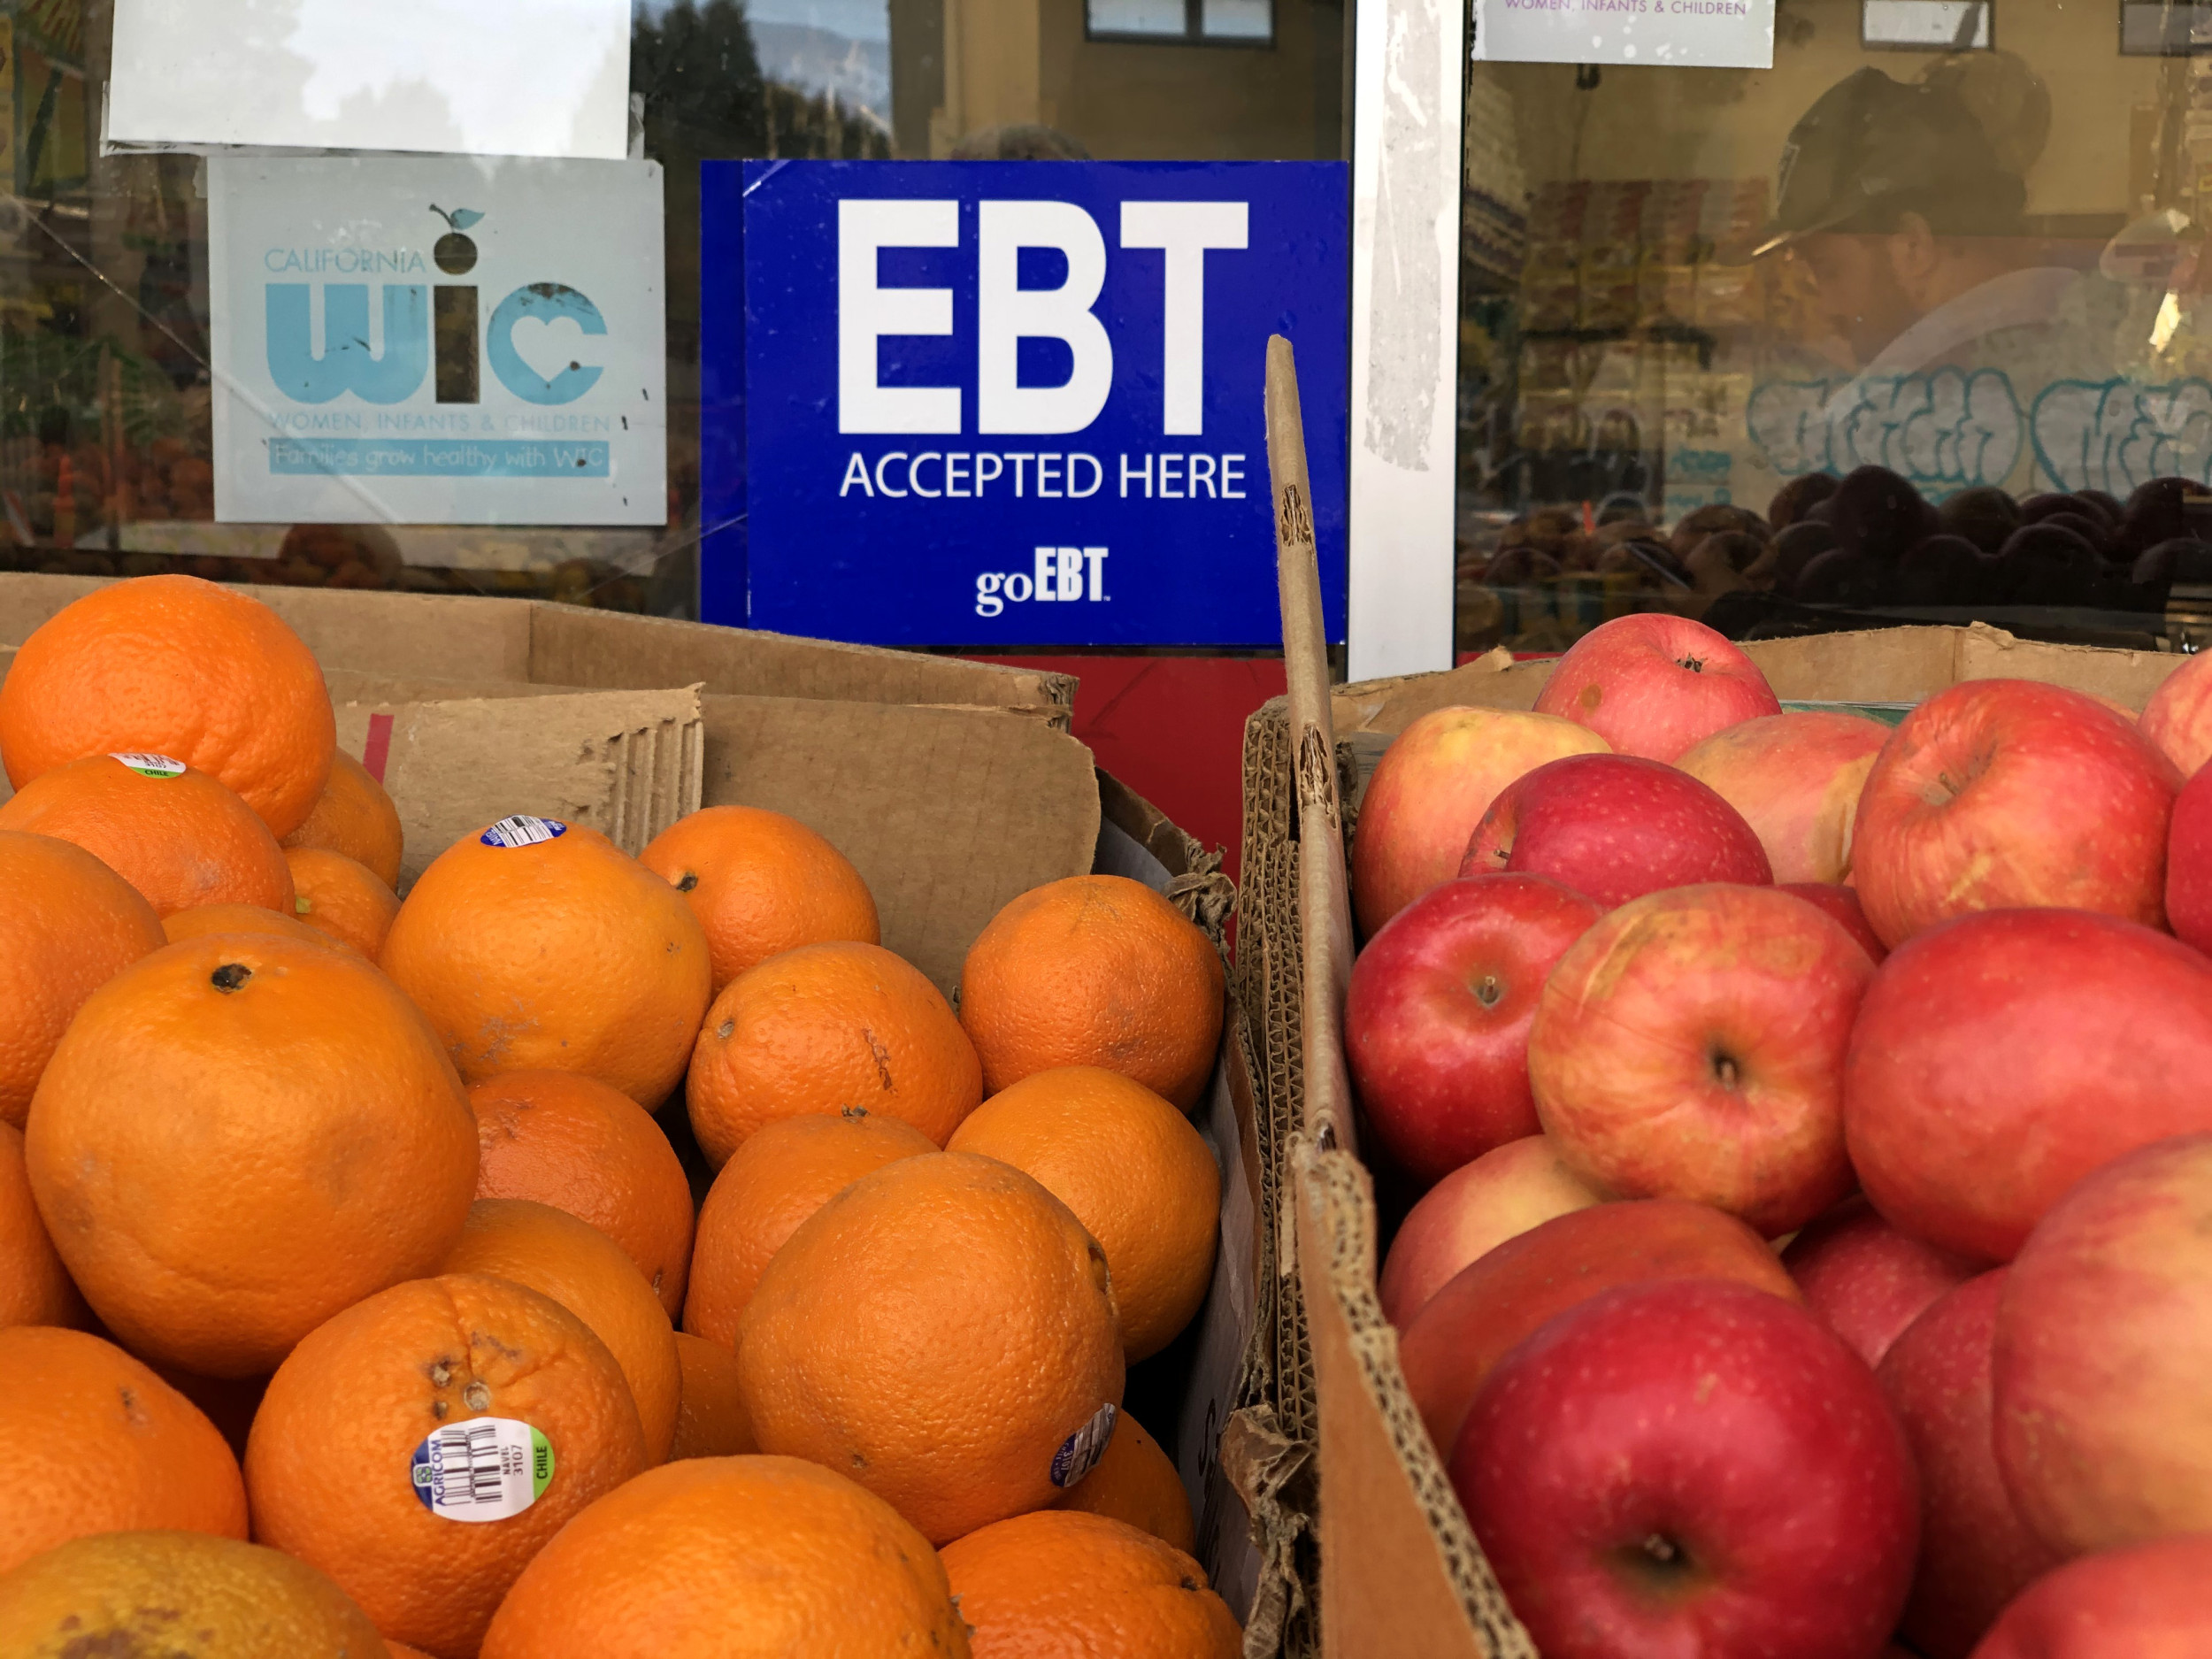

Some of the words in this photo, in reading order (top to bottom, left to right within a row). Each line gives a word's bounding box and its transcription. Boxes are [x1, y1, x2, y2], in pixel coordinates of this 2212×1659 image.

[1582, 0, 1647, 12] INFANTS
[1655, 0, 1664, 12] &
[1671, 1, 1747, 15] CHILDREN
[265, 248, 426, 273] CALIFORNIA
[838, 199, 1249, 436] EBT
[379, 412, 471, 432] INFANTS
[481, 413, 495, 432] &
[504, 414, 610, 433] CHILDREN
[275, 444, 358, 467] Families
[365, 449, 415, 472] grow
[424, 444, 497, 472] healthy
[505, 446, 546, 468] with
[840, 452, 1102, 498] ACCEPTED
[1119, 454, 1246, 498] HERE
[431, 1440, 446, 1506] AGRICOM
[501, 1446, 511, 1475] NAVEL
[511, 1444, 524, 1476] 3107
[535, 1446, 549, 1479] CHILE
